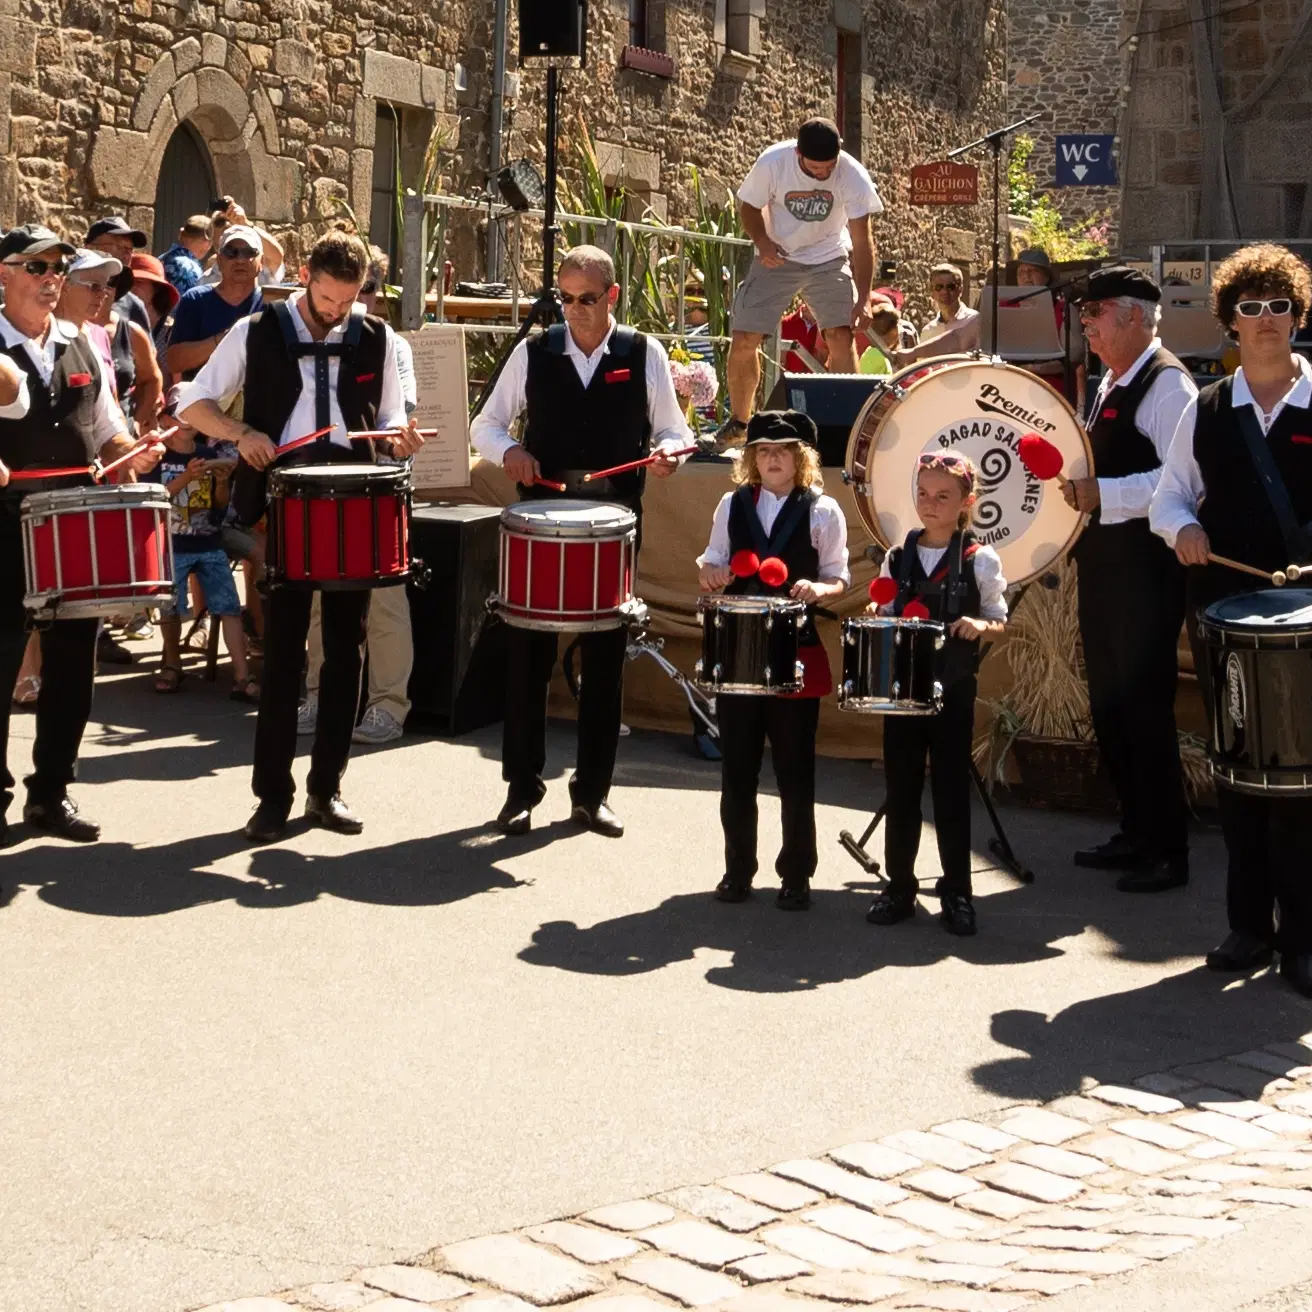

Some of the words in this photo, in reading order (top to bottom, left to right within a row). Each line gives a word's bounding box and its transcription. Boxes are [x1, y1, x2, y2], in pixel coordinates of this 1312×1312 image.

[1061, 142, 1101, 163] WC
[929, 164, 953, 178] AU
[980, 383, 1057, 434] Premier
[937, 422, 992, 449] BAGAD
